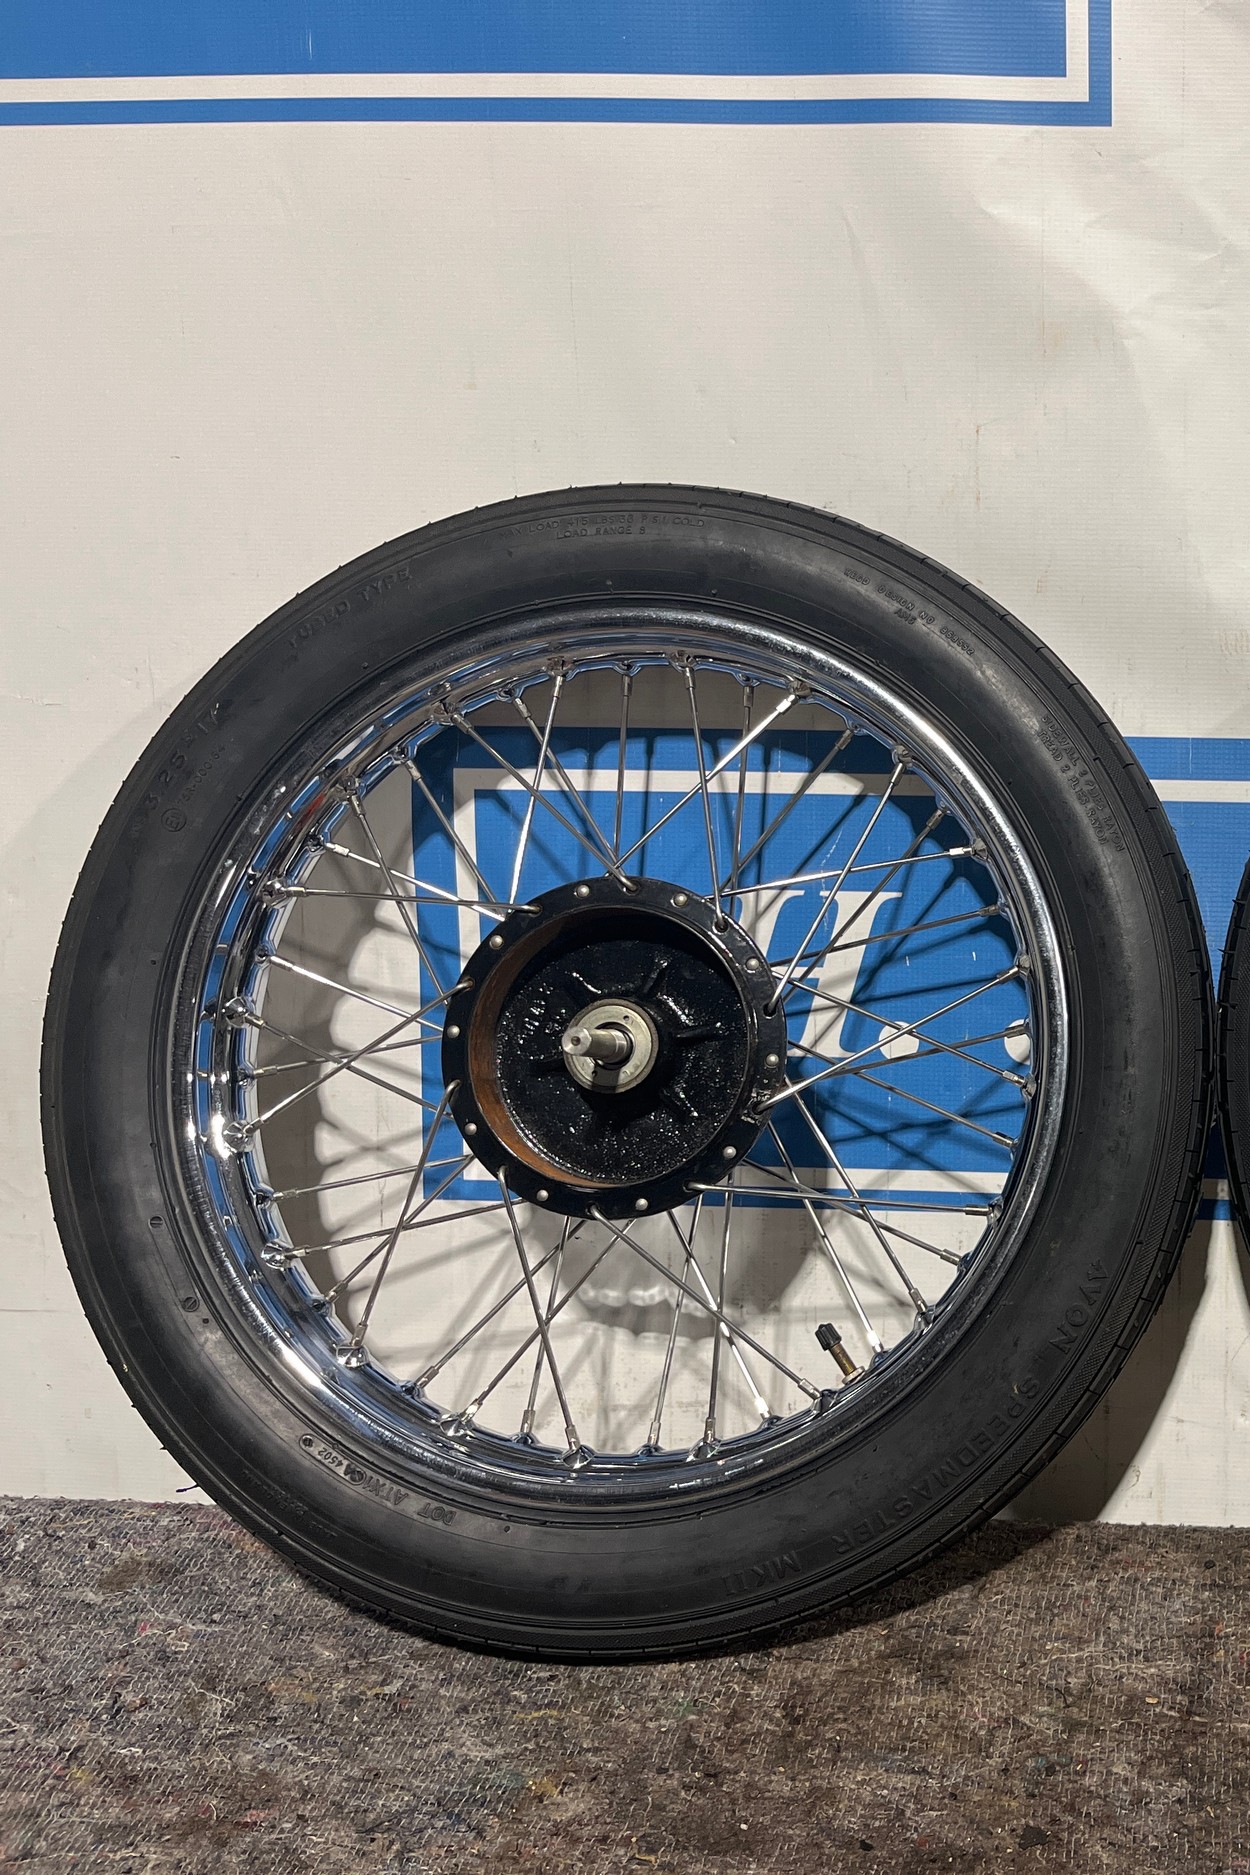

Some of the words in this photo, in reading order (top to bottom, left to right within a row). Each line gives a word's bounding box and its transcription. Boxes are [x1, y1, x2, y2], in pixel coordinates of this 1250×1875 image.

[528, 520, 560, 533] LOAD
[672, 516, 705, 528] COLD
[556, 528, 588, 540] LOAD
[595, 526, 633, 536] RANGE
[1041, 715, 1080, 767] SIDEWALL
[1049, 1260, 1111, 1356] AVON
[316, 1447, 345, 1469] 4502
[831, 1376, 1041, 1556] SPEEDMASTER
[417, 1502, 457, 1526] DOT
